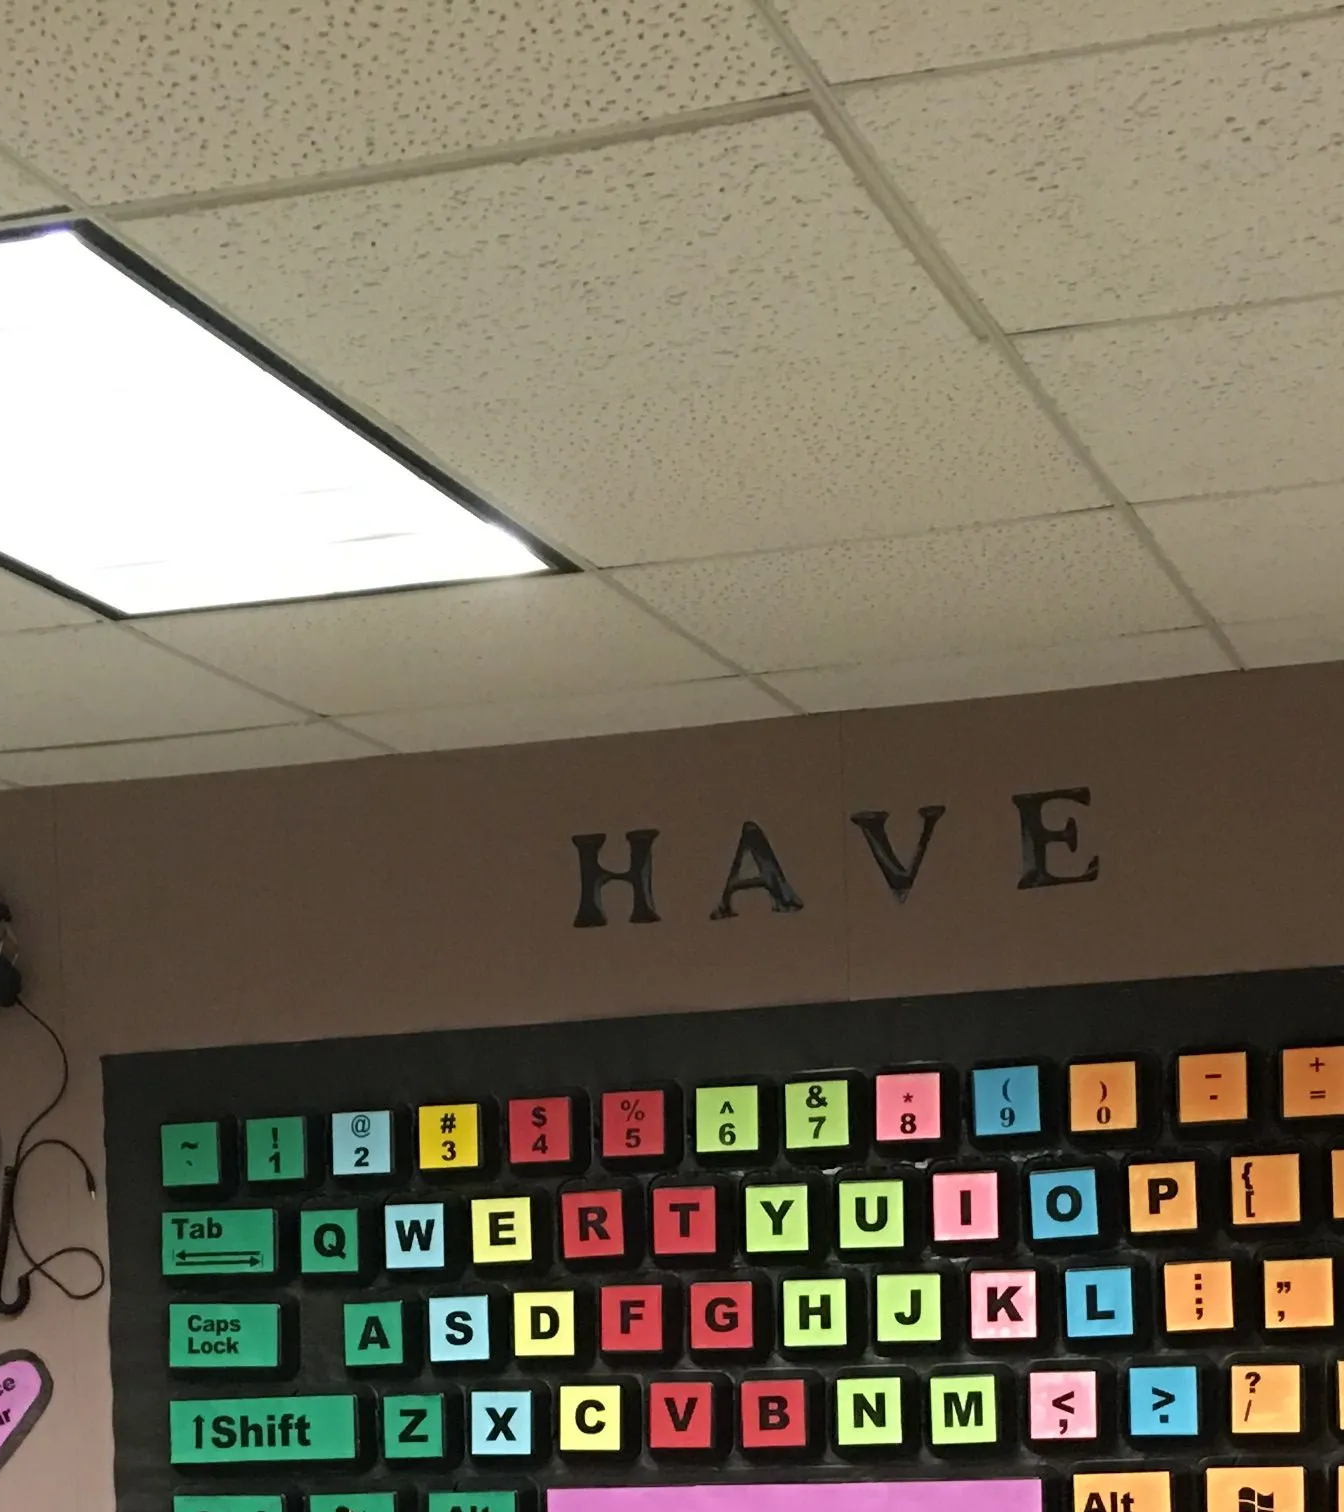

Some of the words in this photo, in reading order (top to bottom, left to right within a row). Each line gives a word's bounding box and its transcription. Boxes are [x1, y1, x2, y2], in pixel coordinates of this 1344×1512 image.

[571, 787, 1099, 928] HAVE
[808, 1116, 826, 1139] 7
[900, 1113, 917, 1134] 8
[1000, 1108, 1015, 1127] 9
[1097, 1107, 1111, 1124] 0
[442, 1141, 456, 1161] 3
[532, 1134, 548, 1154] 4
[625, 1128, 641, 1148] 5
[719, 1123, 736, 1145] 6
[269, 1152, 280, 1173] 1
[355, 1147, 369, 1167] 2
[960, 1190, 971, 1225] I
[1046, 1185, 1082, 1222] O
[1148, 1178, 1178, 1214] P
[171, 1217, 224, 1242] Tab
[489, 1212, 516, 1246] E
[578, 1207, 610, 1241] R
[669, 1203, 699, 1237] T
[760, 1200, 793, 1235] Y
[855, 1196, 888, 1232] U
[314, 1223, 346, 1259] Q
[395, 1219, 435, 1251] W
[620, 1300, 645, 1334] F
[705, 1298, 738, 1332] G
[799, 1295, 831, 1330] H
[895, 1290, 921, 1325] J
[987, 1286, 1023, 1322] K
[1086, 1285, 1115, 1320] L
[186, 1313, 242, 1337] Caps
[358, 1316, 390, 1350] A
[446, 1311, 473, 1345] S
[531, 1306, 559, 1339] D
[186, 1335, 241, 1355] Lock
[399, 1409, 428, 1442] Z
[486, 1408, 517, 1441] X
[575, 1400, 605, 1434] C
[664, 1397, 698, 1431] V
[758, 1396, 790, 1430] B
[853, 1393, 886, 1428] N
[944, 1391, 983, 1427] M
[211, 1412, 313, 1449] Shift
